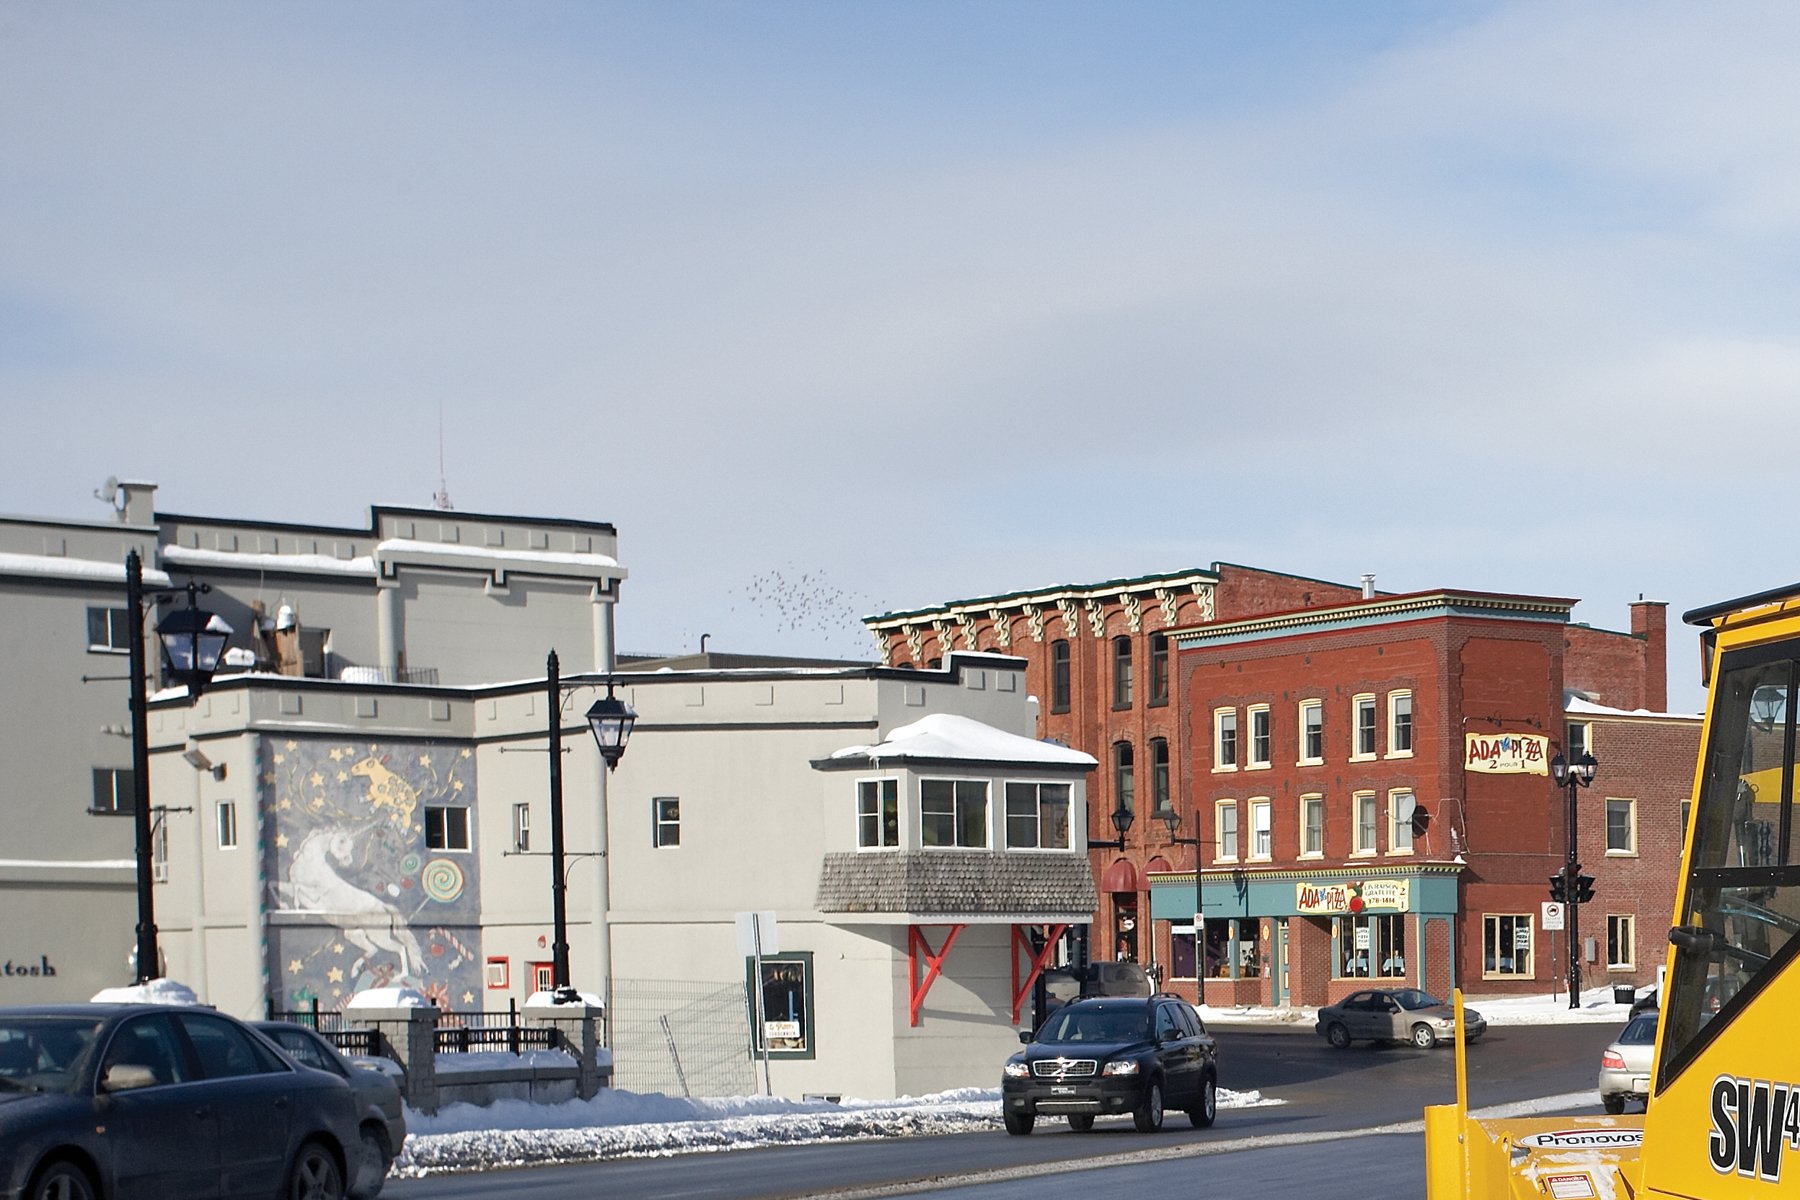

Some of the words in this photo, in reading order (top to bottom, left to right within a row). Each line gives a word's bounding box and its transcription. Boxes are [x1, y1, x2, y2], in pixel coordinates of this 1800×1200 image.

[1469, 738, 1501, 764] ADA
[1511, 737, 1544, 761] PIZZA
[1489, 759, 1498, 769] 2
[1521, 760, 1526, 769] 1
[1299, 887, 1320, 909] ADA
[1327, 887, 1346, 910] PIZZA
[1399, 887, 1406, 896] 2
[0, 954, 57, 977] tosh
